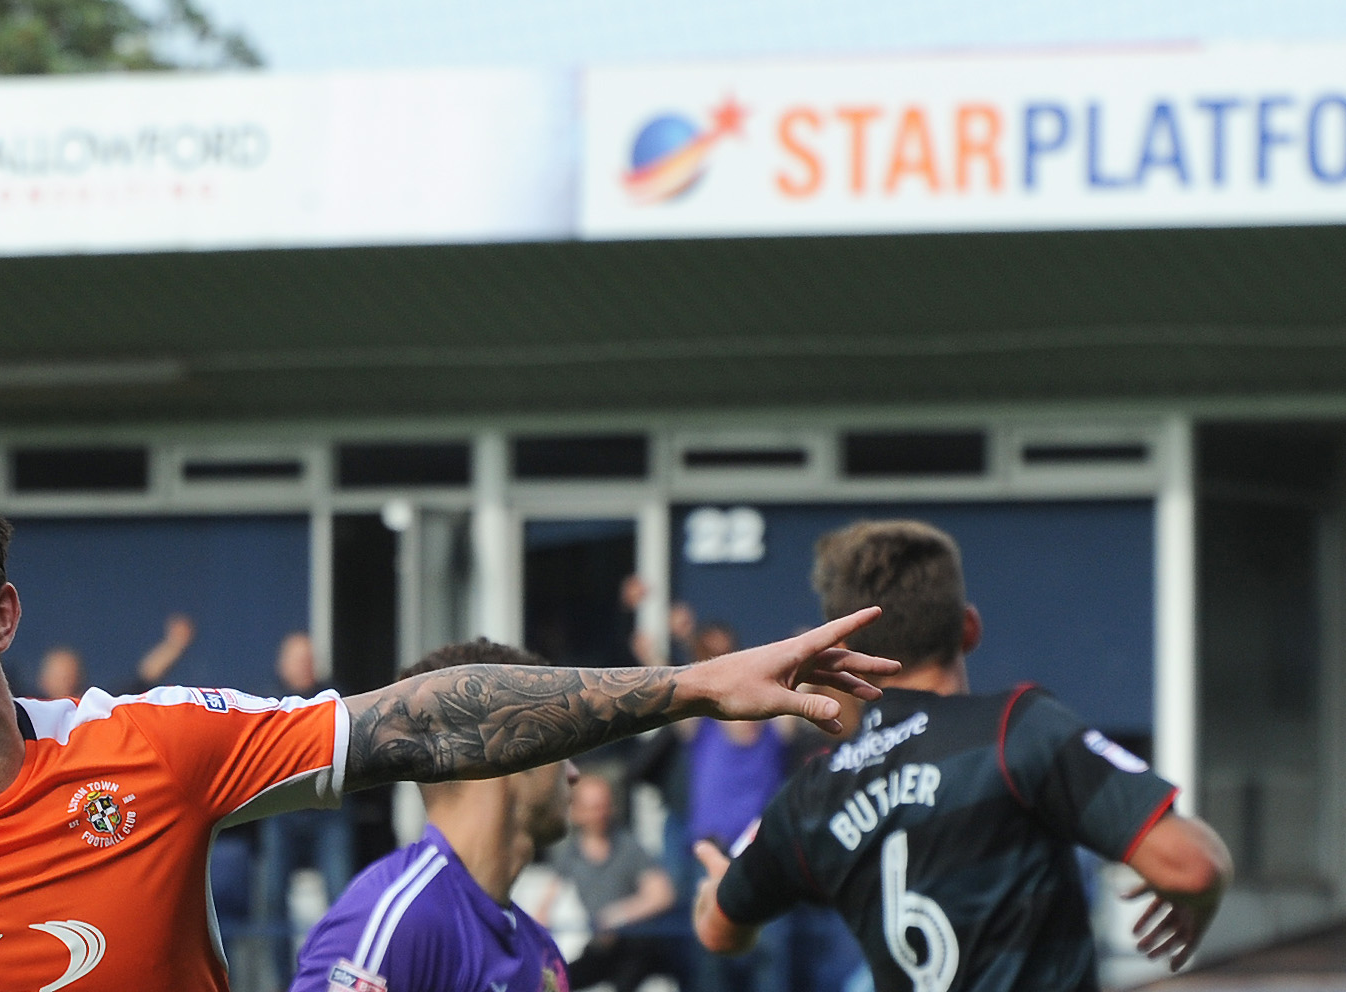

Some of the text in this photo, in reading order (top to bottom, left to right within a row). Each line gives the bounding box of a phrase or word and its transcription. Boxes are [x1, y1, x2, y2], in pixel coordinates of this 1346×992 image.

[684, 508, 766, 563] 22
[86, 780, 119, 792] TOWN
[81, 830, 125, 848] FOOTBALL
